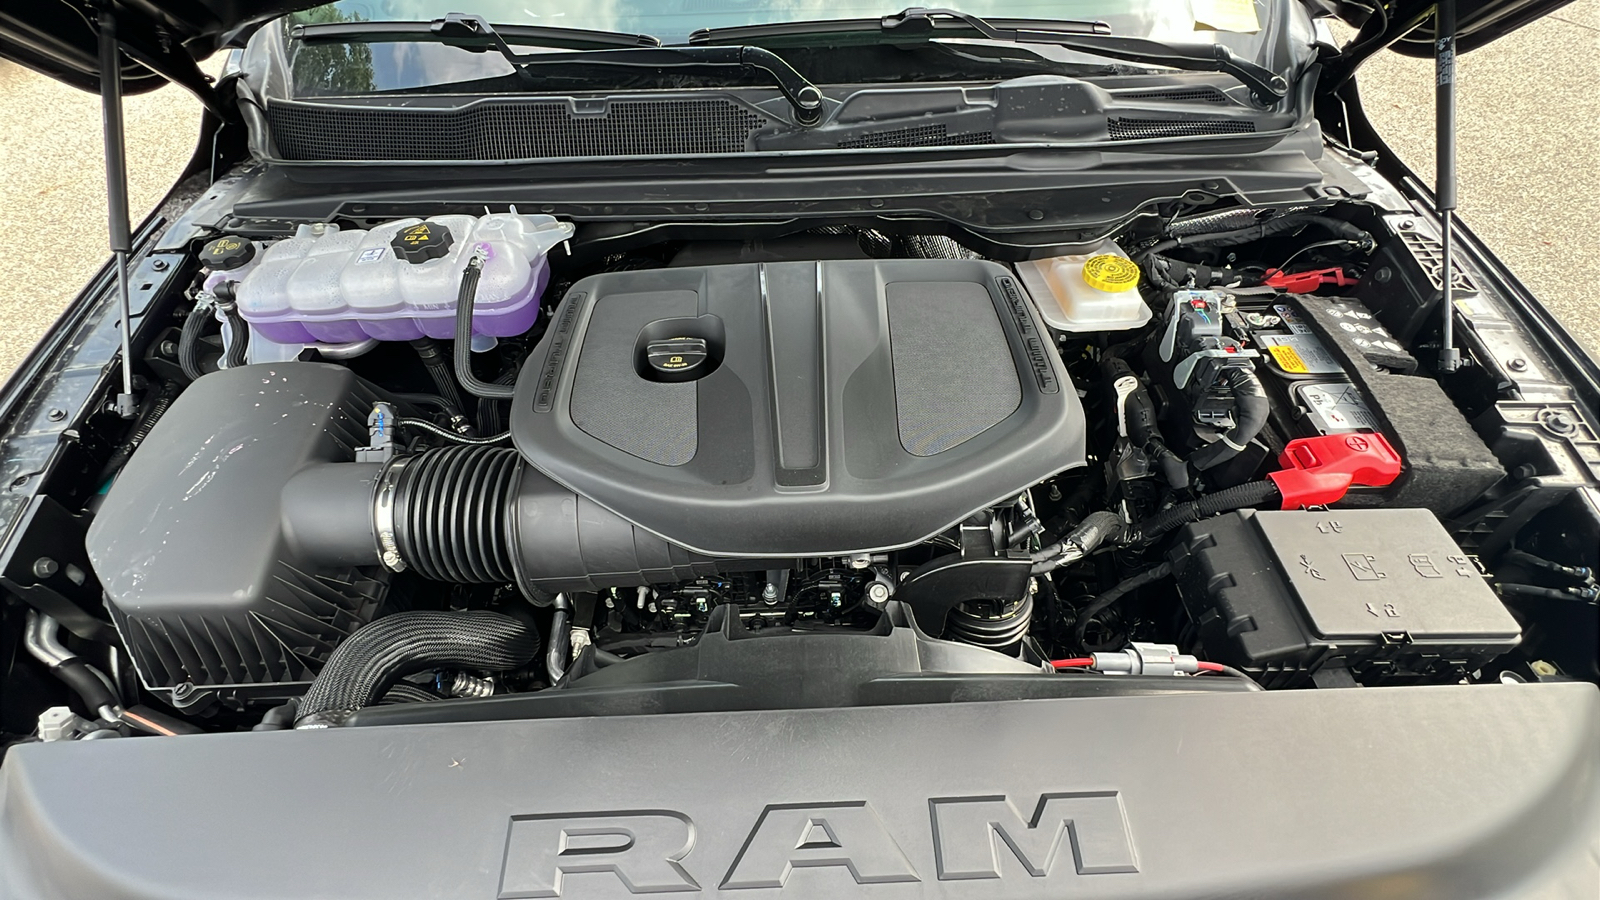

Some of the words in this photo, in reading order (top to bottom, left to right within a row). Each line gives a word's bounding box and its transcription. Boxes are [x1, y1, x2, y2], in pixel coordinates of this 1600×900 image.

[560, 293, 582, 334] TWIN
[1000, 277, 1032, 335] TURBO
[538, 342, 562, 407] TURBO
[1028, 337, 1052, 389] TWIN
[497, 790, 1140, 899] RAM
